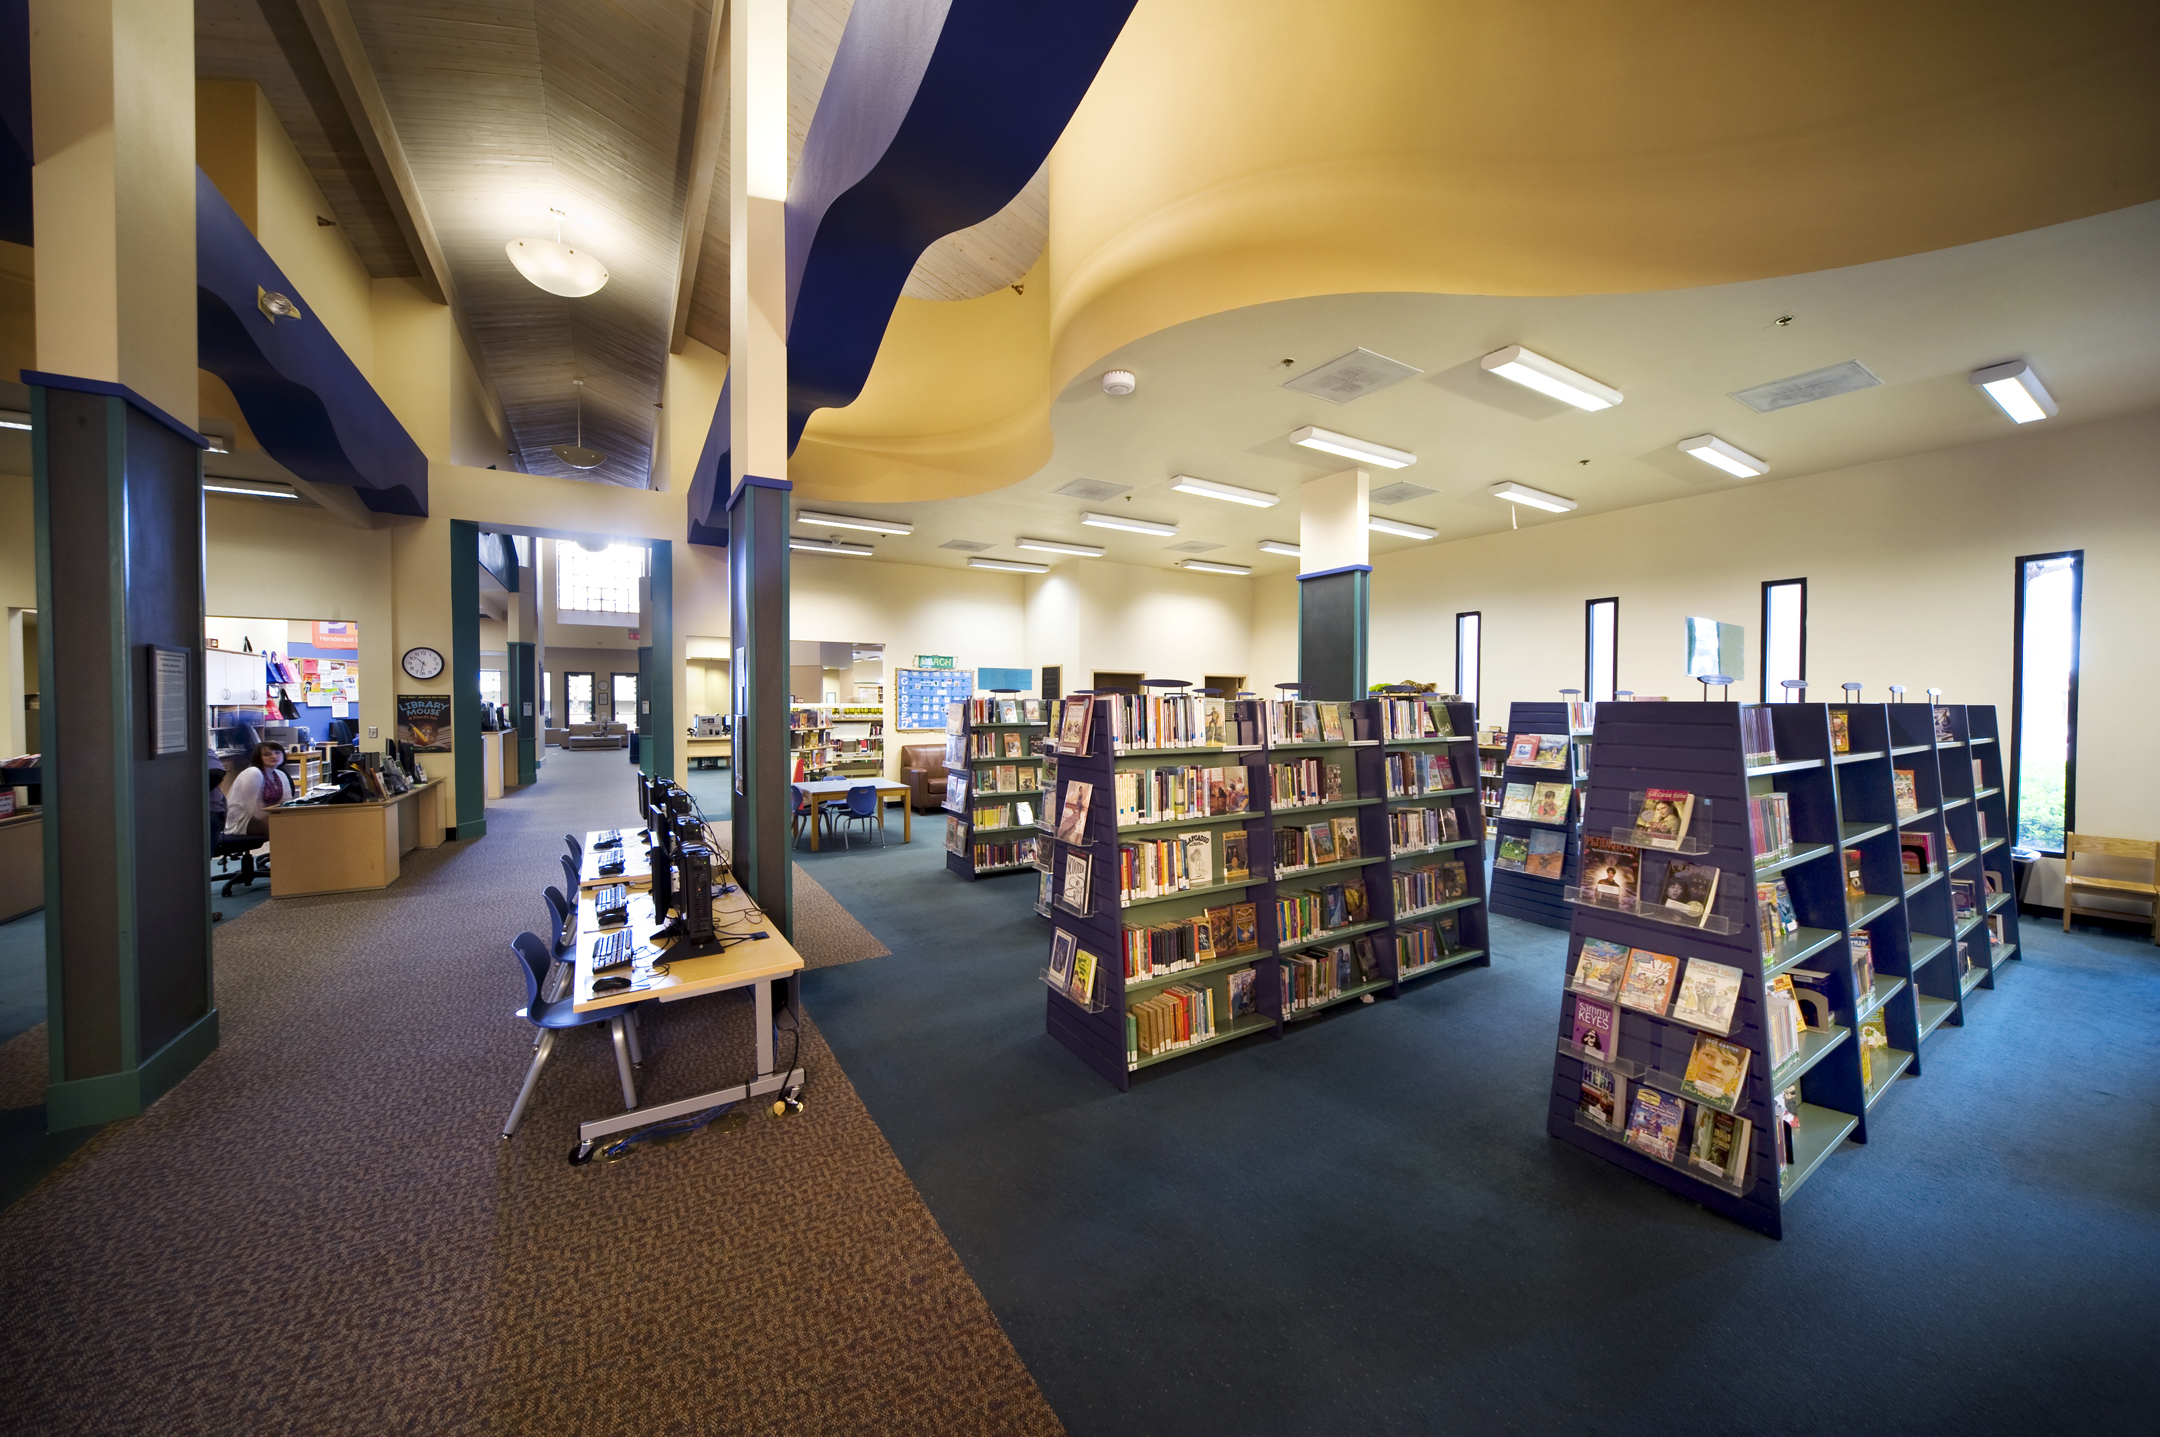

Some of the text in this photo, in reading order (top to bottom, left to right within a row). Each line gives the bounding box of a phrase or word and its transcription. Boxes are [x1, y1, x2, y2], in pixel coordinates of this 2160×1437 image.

[320, 635, 354, 643] Henderson
[920, 656, 951, 666] MARCH
[398, 701, 449, 711] LIBRARY
[901, 677, 909, 728] CLOSED
[1067, 857, 1085, 875] SCOOTER
[1671, 864, 1711, 879] CRISPIN
[1579, 1002, 1610, 1021] sammy
[1578, 1010, 1609, 1030] KEYES
[1706, 1038, 1739, 1053] JACK GANTOS
[1584, 1069, 1613, 1094] HERO
[1684, 1085, 1697, 1094] What
